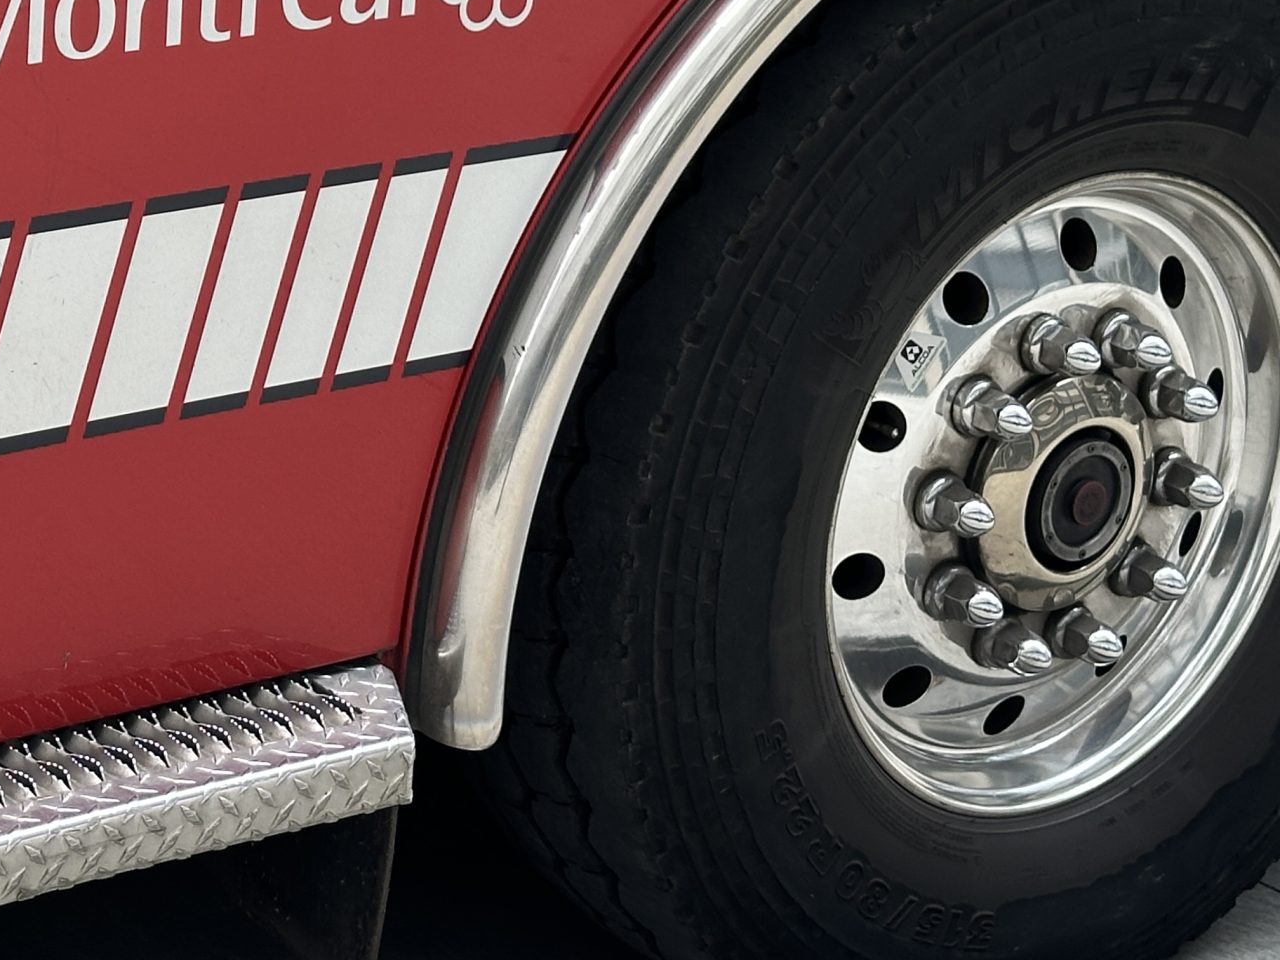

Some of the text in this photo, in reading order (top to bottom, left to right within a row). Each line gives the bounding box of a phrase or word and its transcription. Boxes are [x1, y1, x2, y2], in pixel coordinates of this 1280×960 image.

[912, 52, 1265, 239] MICHELIN
[911, 345, 935, 377] ALCOA
[833, 858, 997, 954] 315/80
